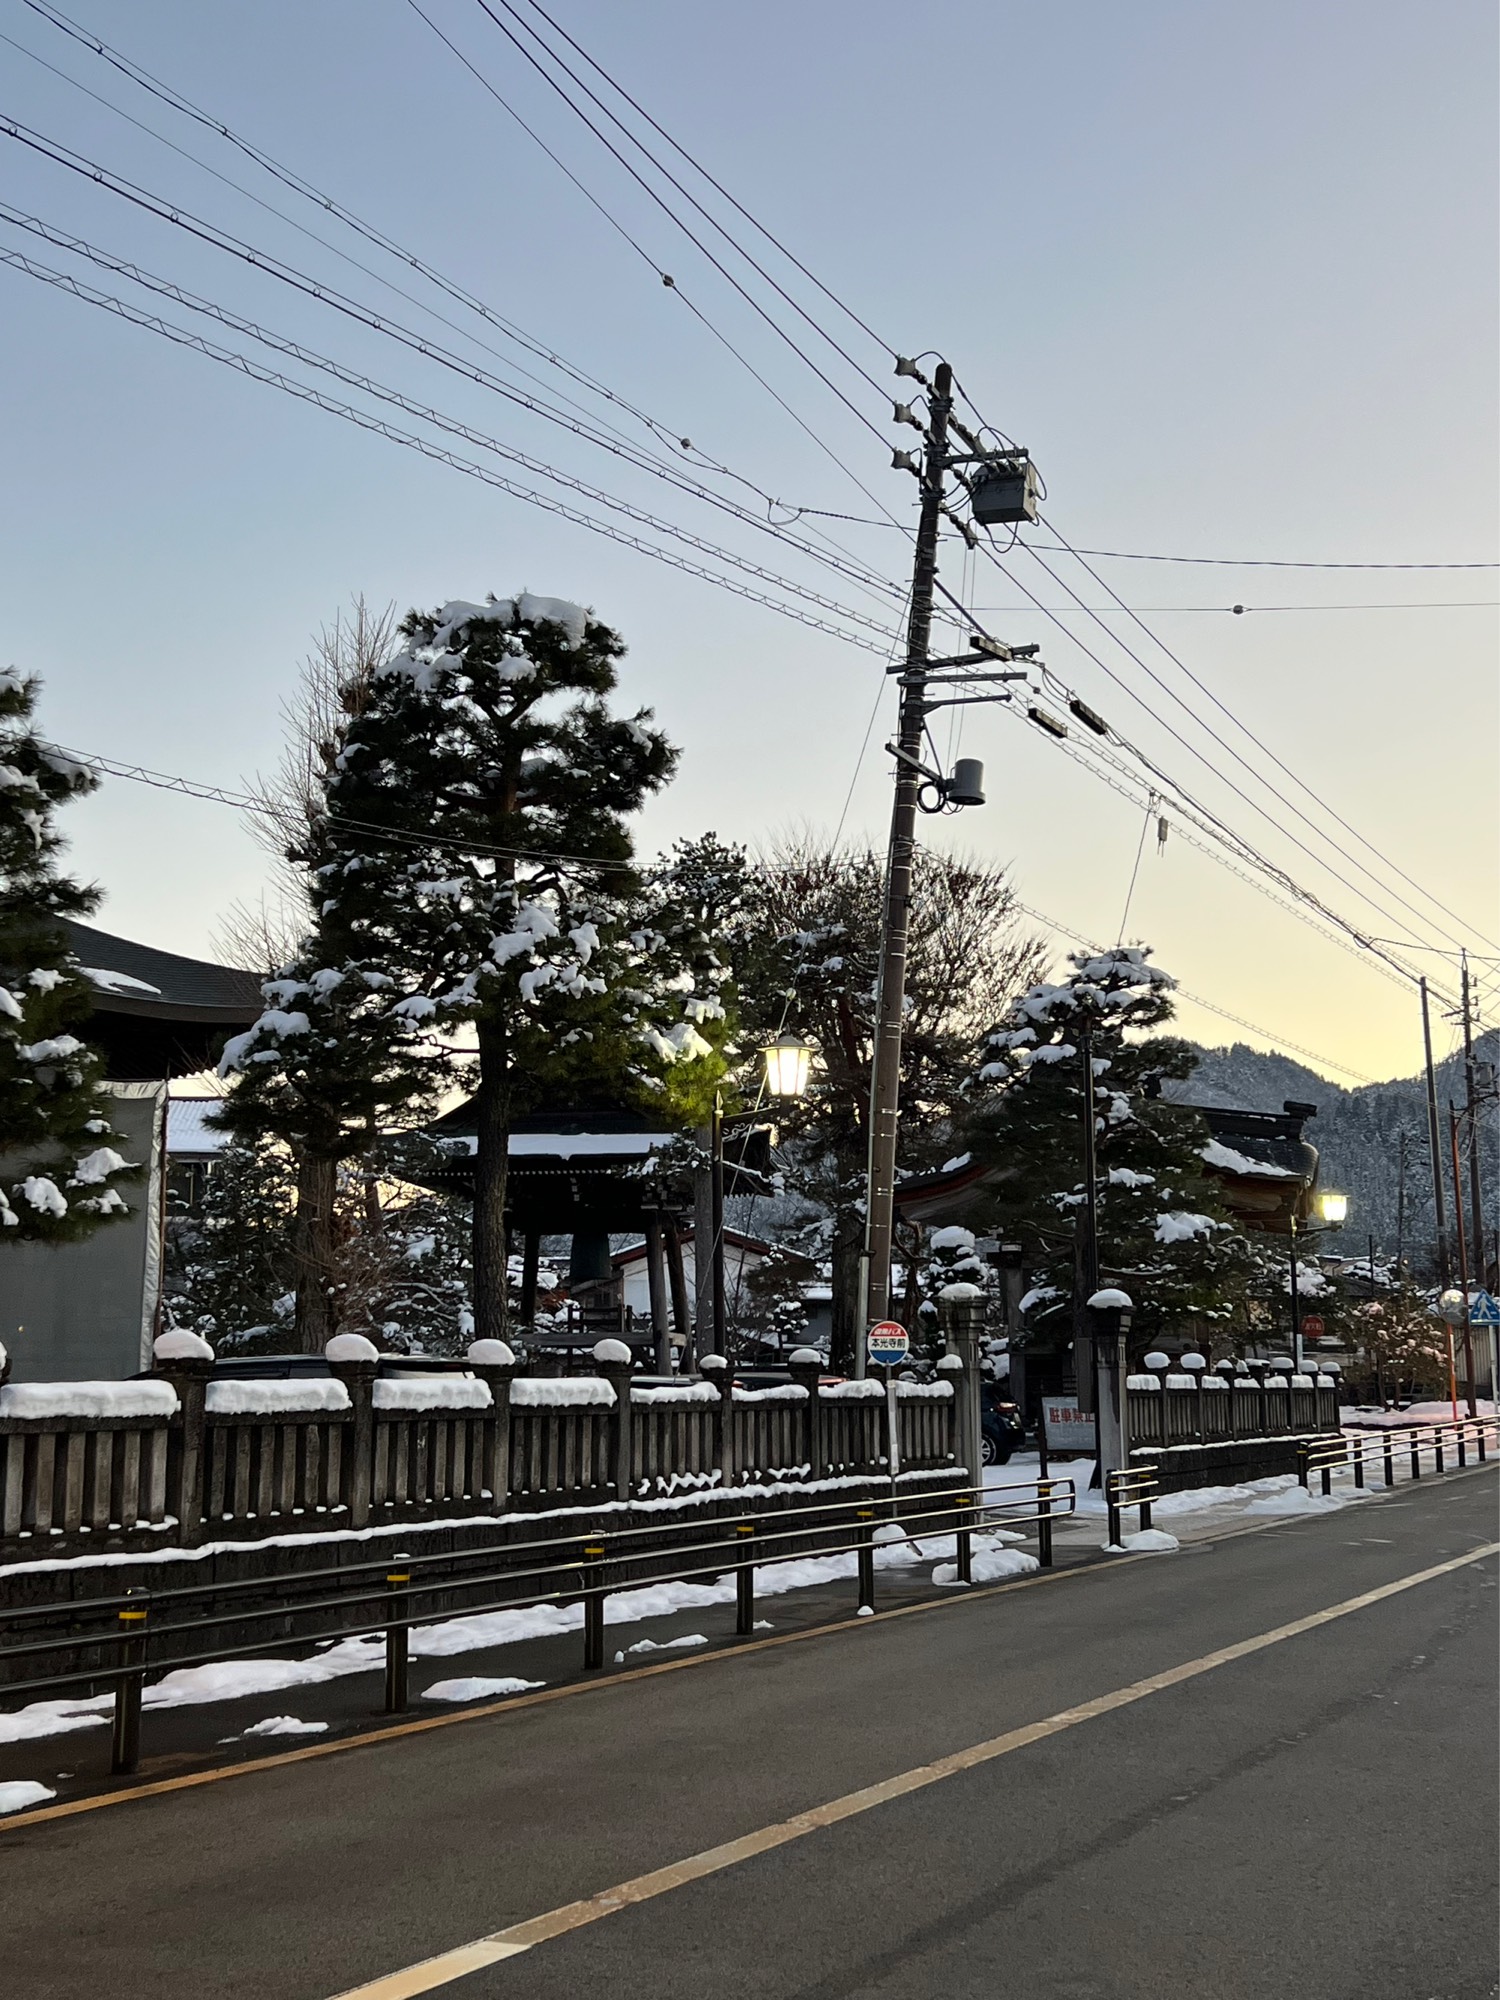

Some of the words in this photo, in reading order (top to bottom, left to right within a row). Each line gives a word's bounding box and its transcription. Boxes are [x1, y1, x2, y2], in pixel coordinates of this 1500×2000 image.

[871, 1338, 906, 1348] 本光寺前
[1049, 1407, 1095, 1423] 駐車禁止
